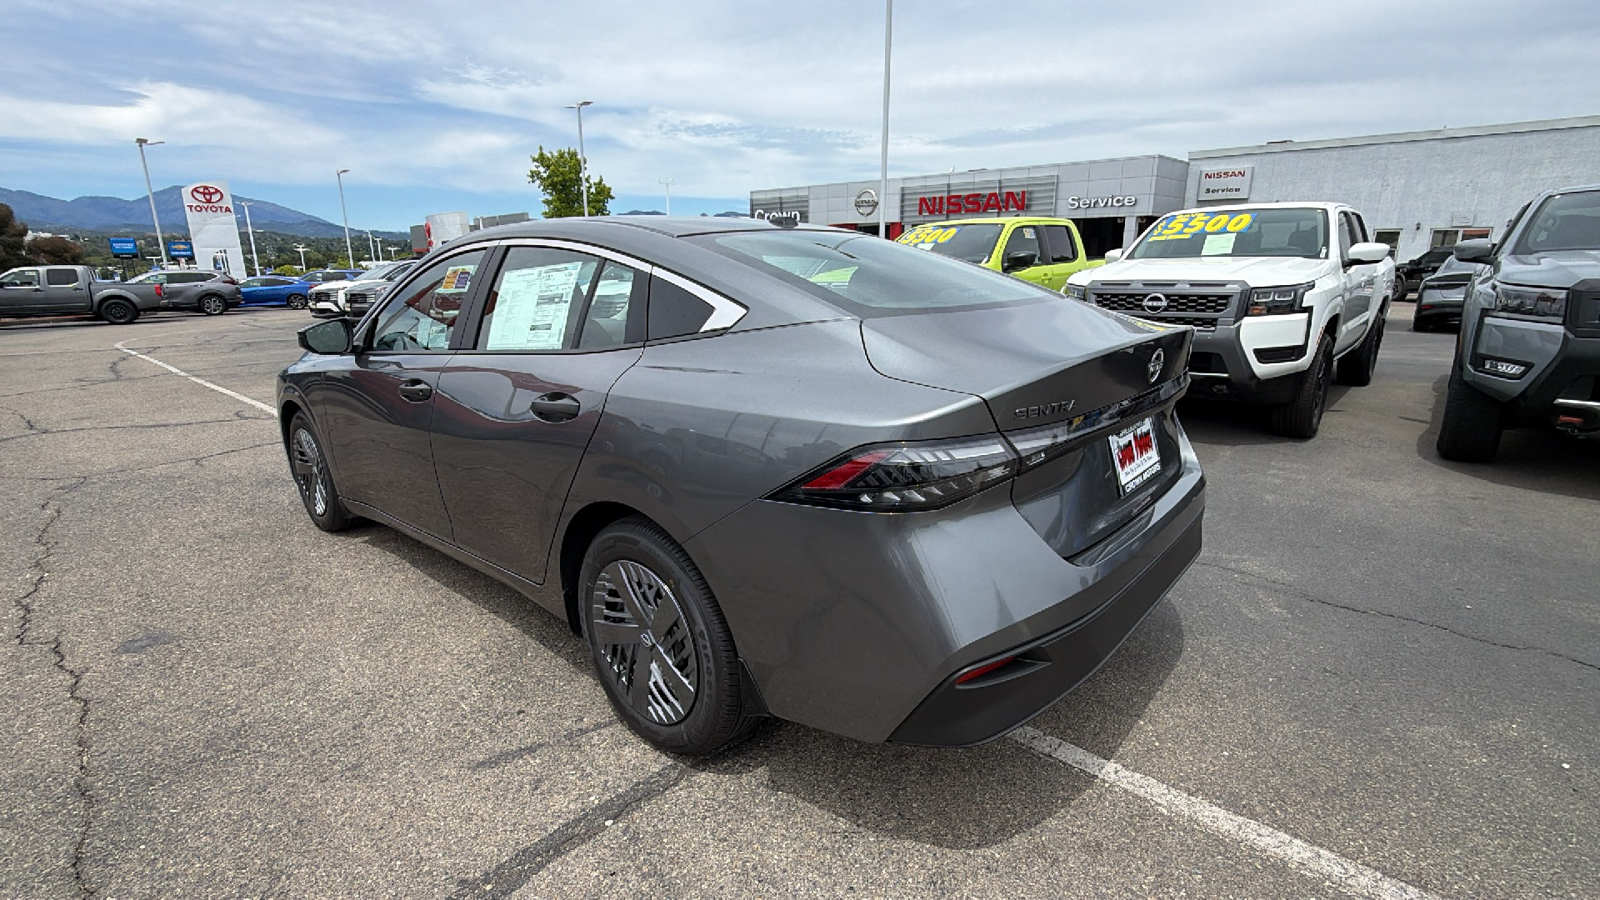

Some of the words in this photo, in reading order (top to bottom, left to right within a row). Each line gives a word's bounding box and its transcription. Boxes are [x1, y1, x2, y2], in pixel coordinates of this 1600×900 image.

[1204, 170, 1246, 179] NISSAN
[186, 204, 233, 214] TOYOTA
[918, 190, 1027, 215] NISSAN
[1067, 194, 1137, 210] Service
[1153, 213, 1253, 236] $5500
[1013, 399, 1076, 421] SENTRA
